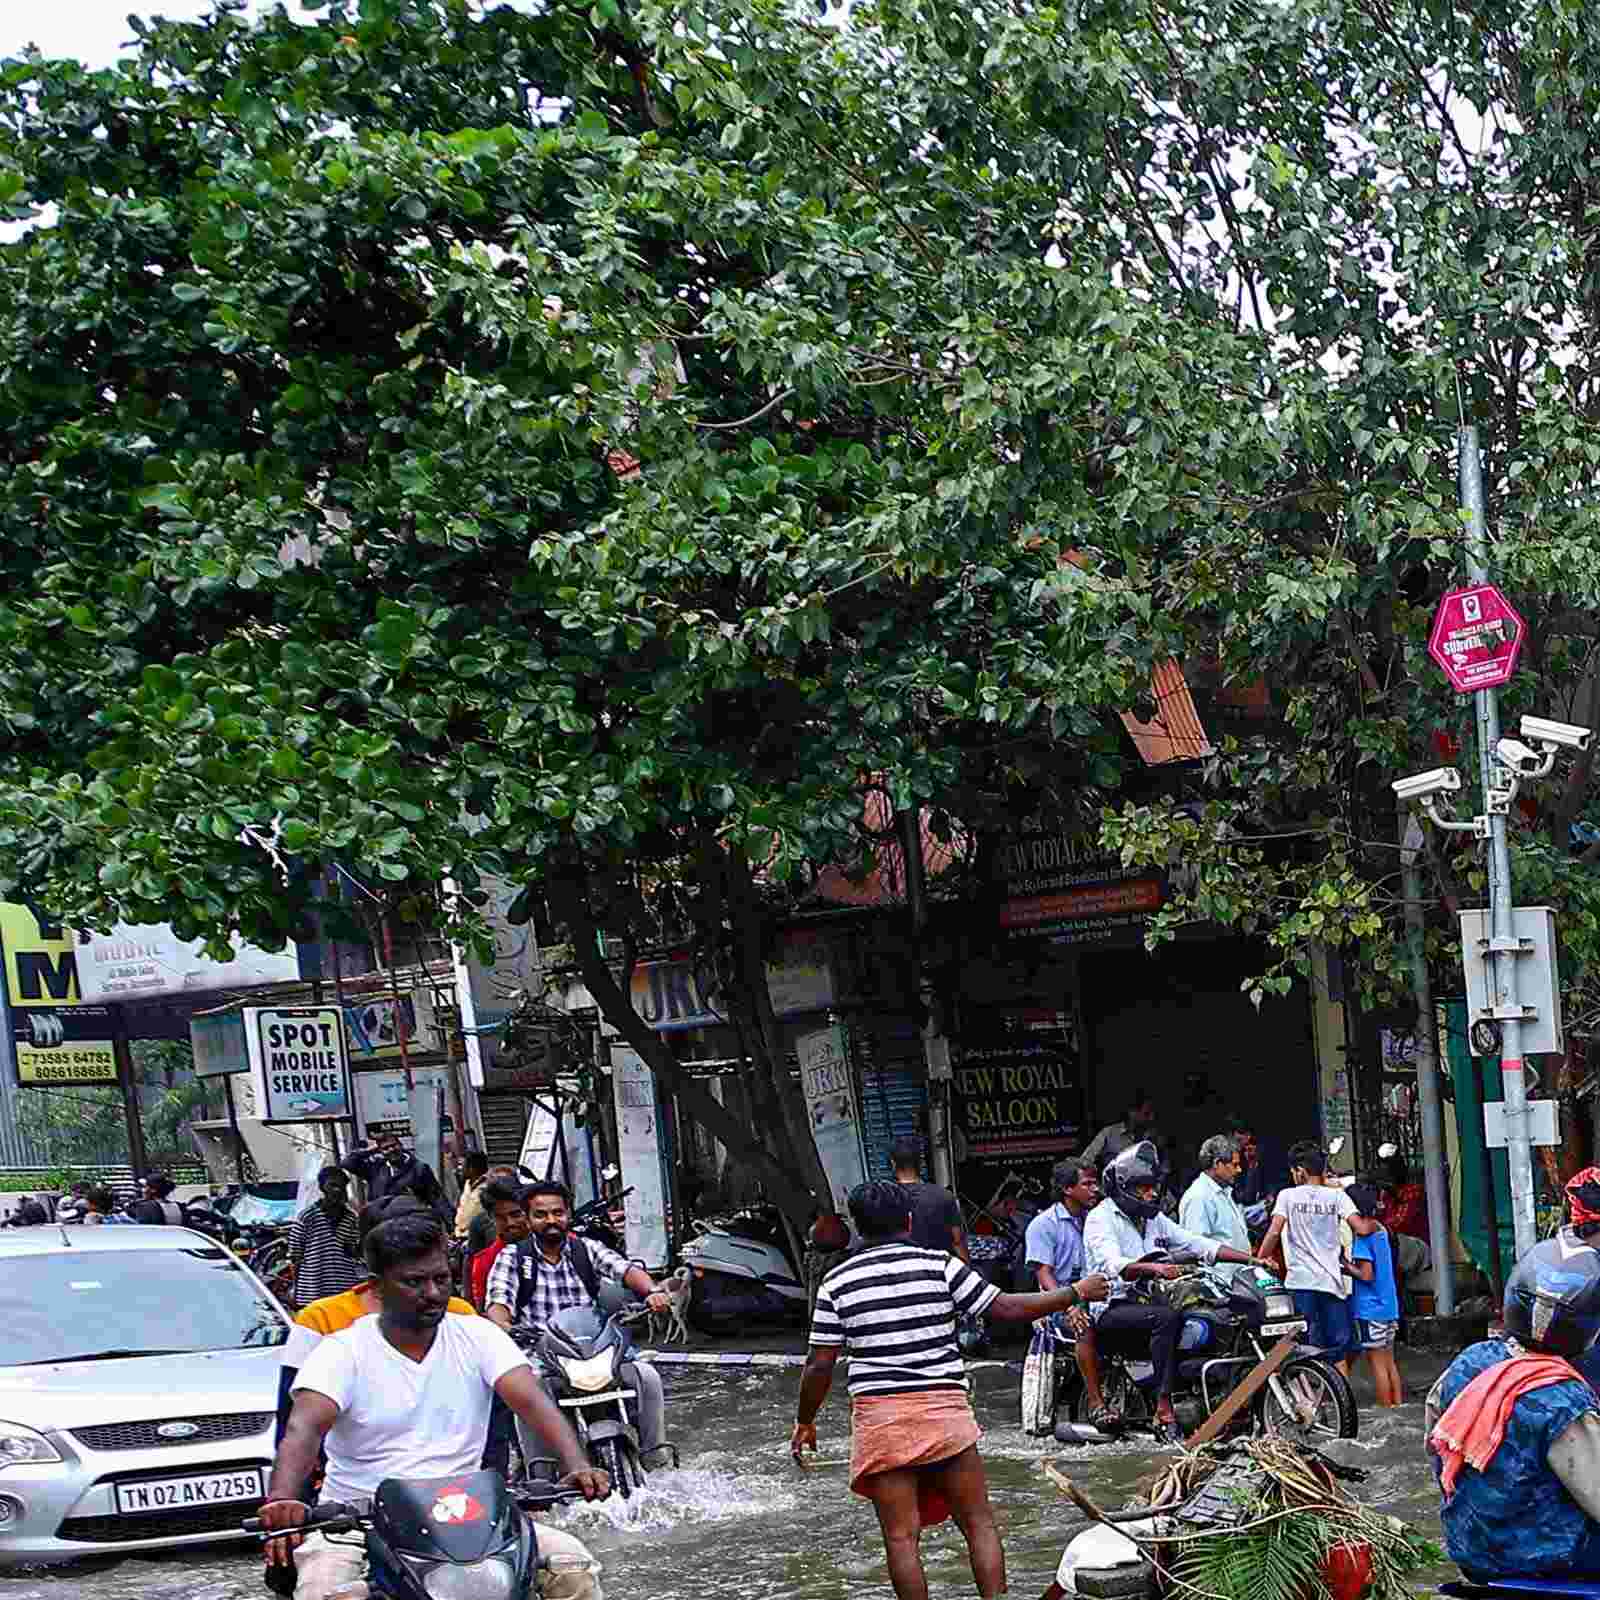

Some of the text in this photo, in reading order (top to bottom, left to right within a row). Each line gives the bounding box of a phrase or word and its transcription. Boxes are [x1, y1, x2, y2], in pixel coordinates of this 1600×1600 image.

[268, 1024, 332, 1048] SPOT
[271, 1052, 336, 1071] MOBILE
[273, 1074, 338, 1094] SERVICE
[1000, 1063, 1072, 1092] ROYAL
[966, 1096, 1057, 1128] SALOON
[124, 1476, 257, 1508] TN 02 AK 2259
